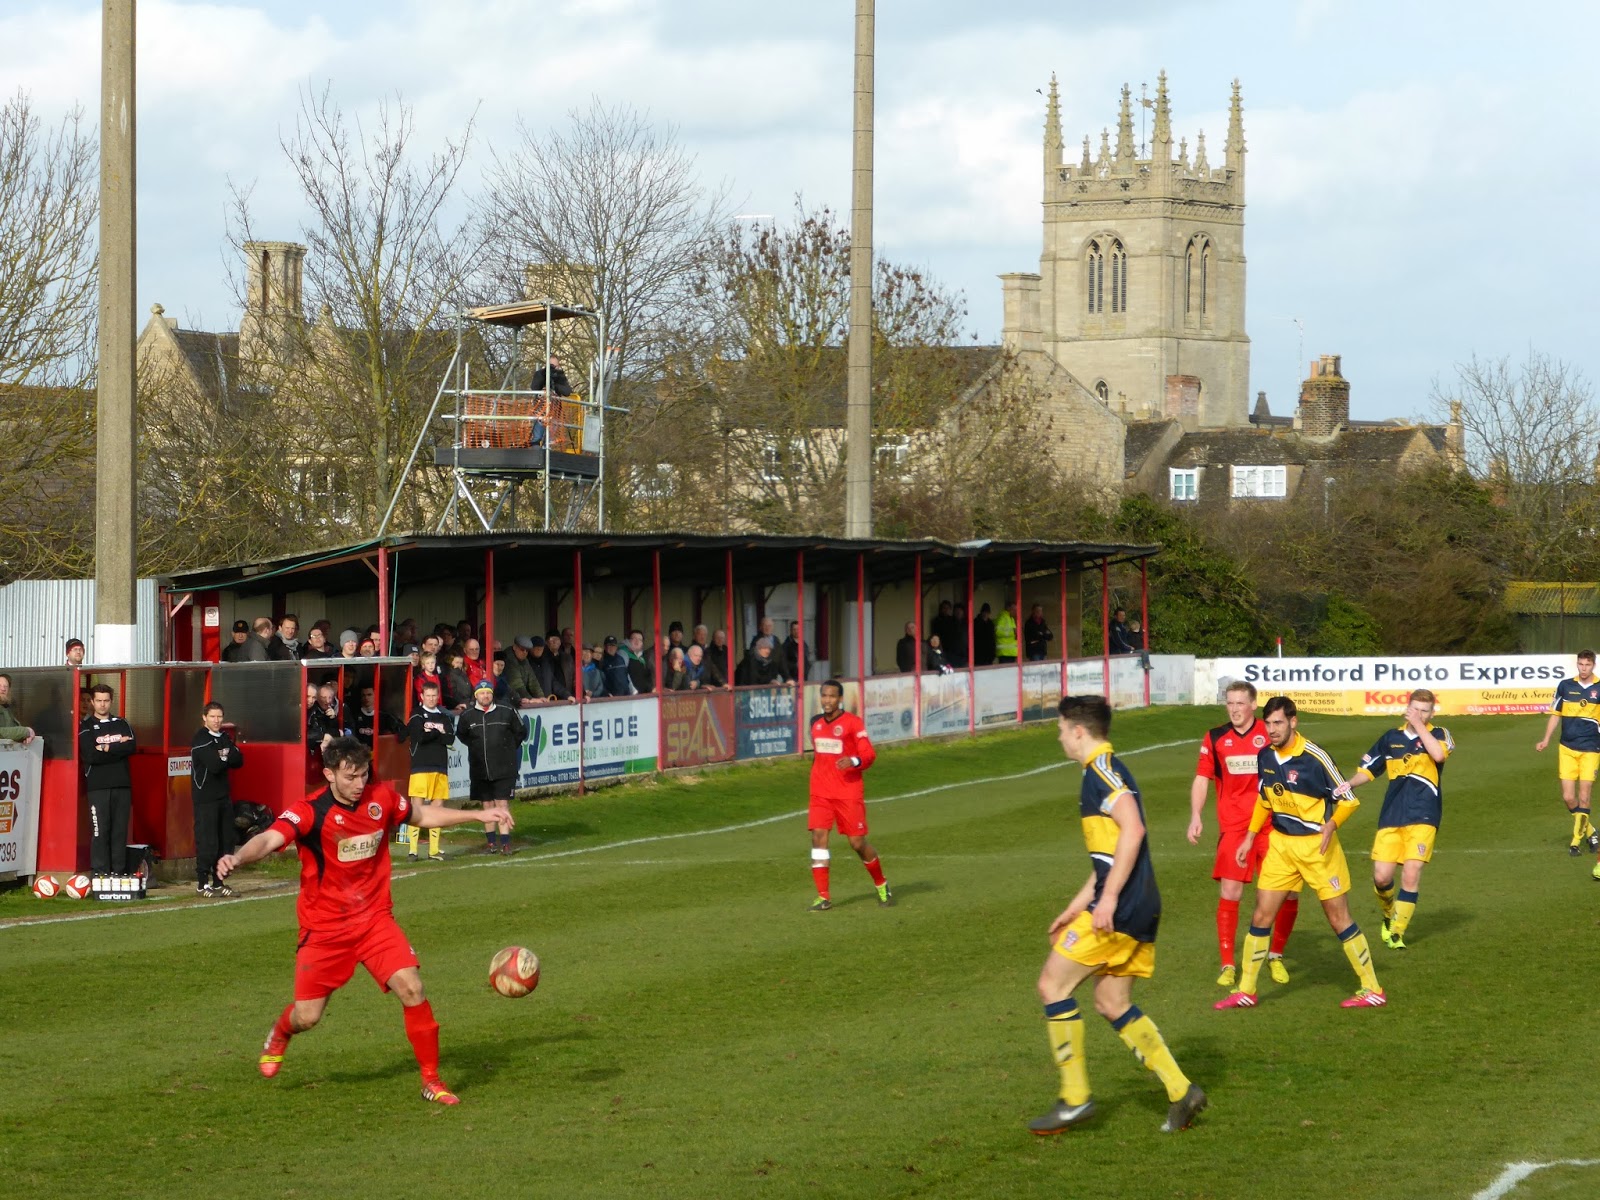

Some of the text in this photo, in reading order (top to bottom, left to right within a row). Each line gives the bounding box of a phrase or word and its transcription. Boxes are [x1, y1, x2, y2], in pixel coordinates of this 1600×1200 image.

[1244, 662, 1566, 685] Stamford Photo Express
[1481, 689, 1556, 701] Quality & Servi
[1466, 704, 1550, 713] Digital Solutions
[169, 760, 192, 772] STAMFOR
[448, 751, 462, 769] o.uk
[1229, 760, 1259, 768] C.S.ELLI
[0, 769, 21, 801] es
[0, 842, 17, 862] 393
